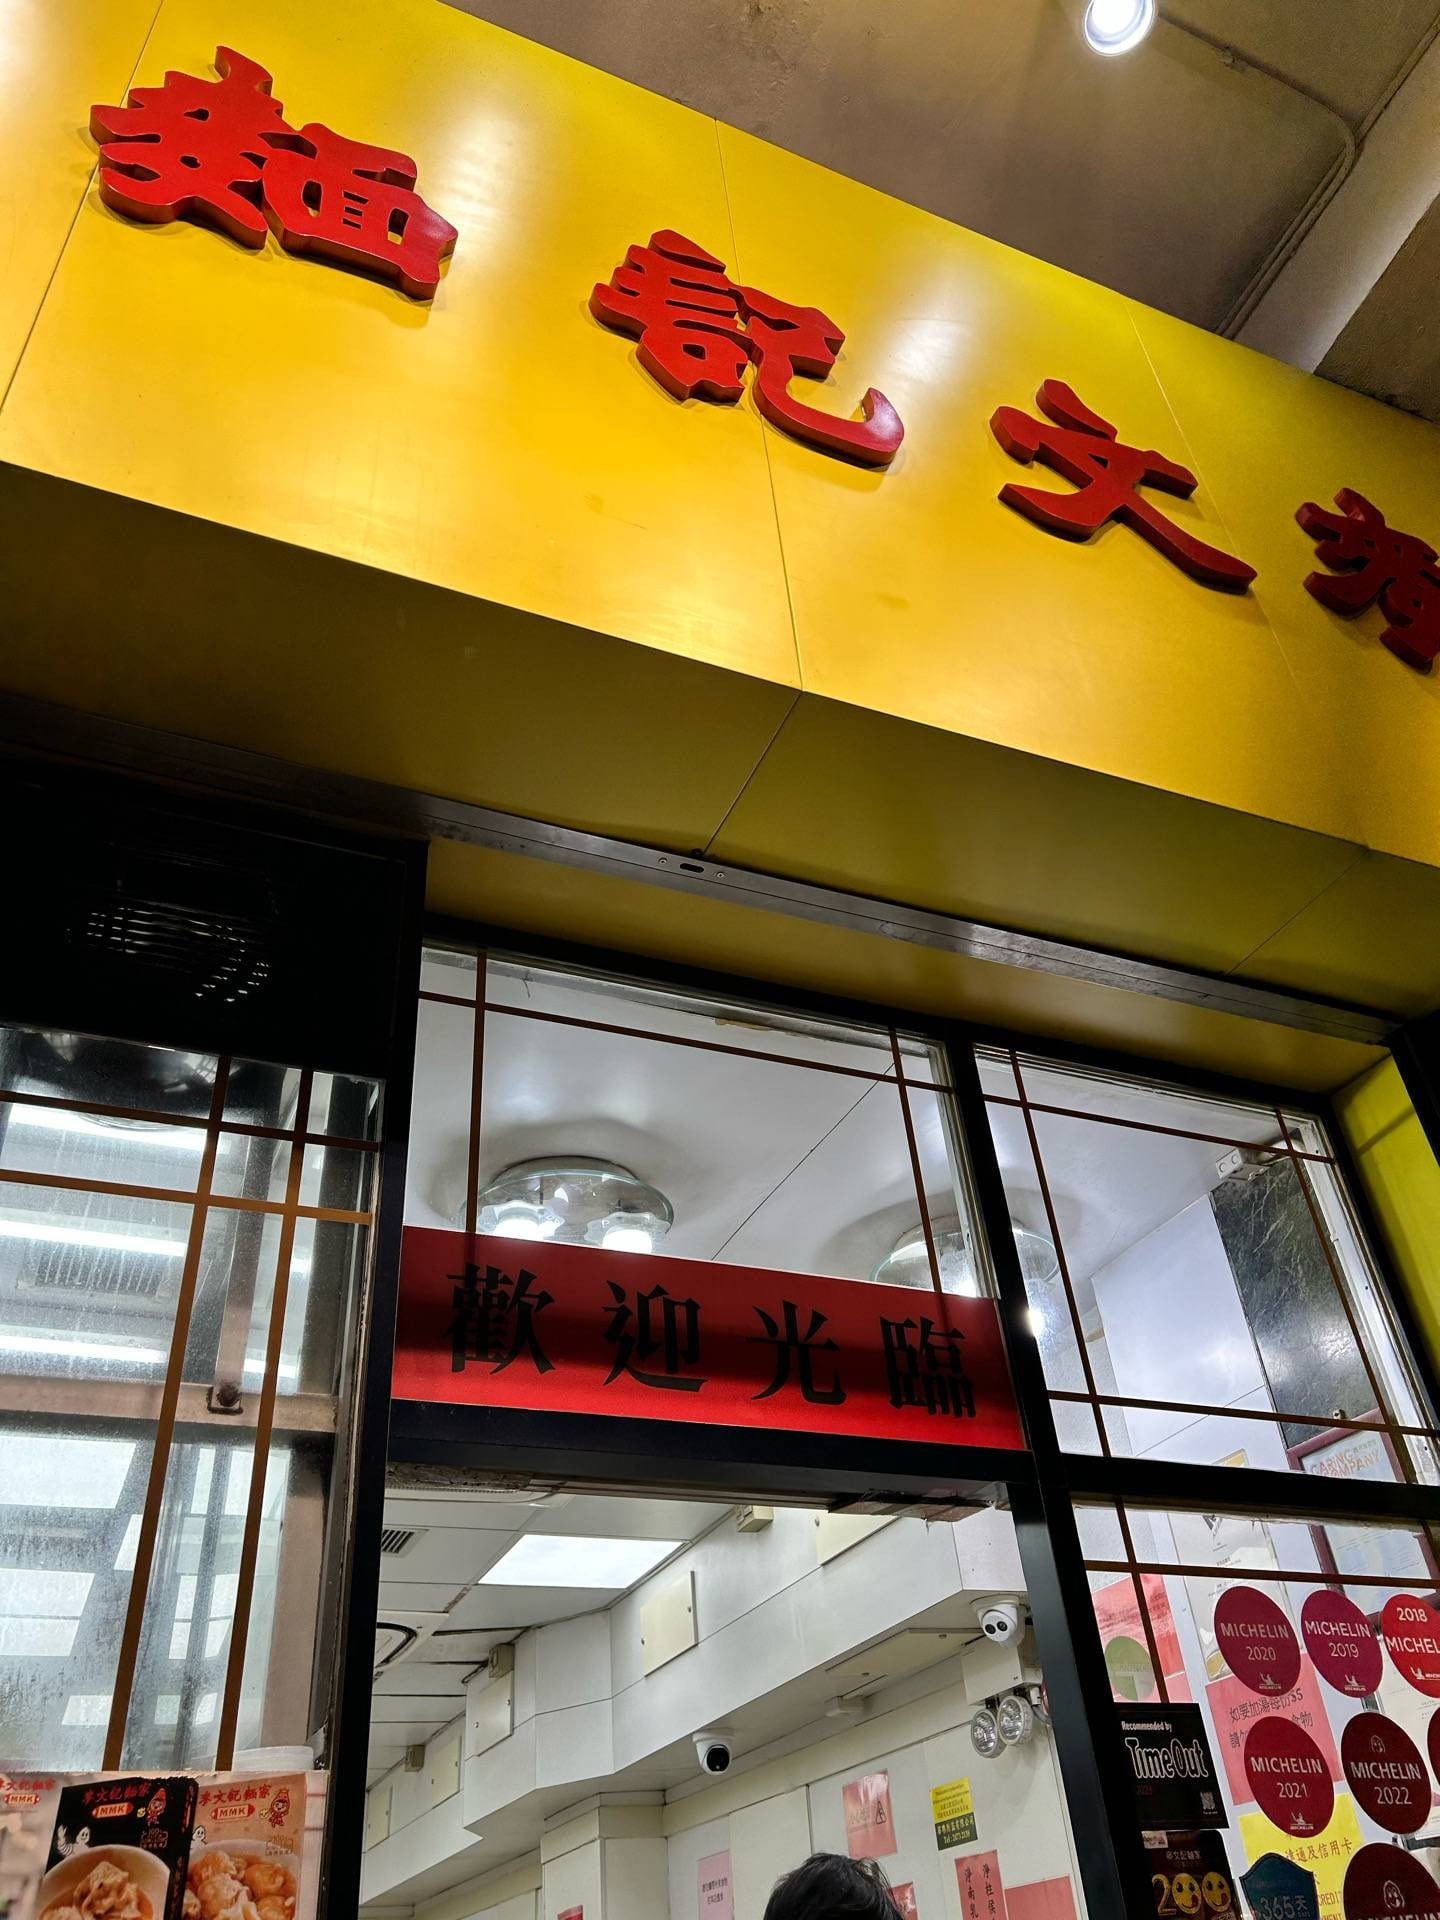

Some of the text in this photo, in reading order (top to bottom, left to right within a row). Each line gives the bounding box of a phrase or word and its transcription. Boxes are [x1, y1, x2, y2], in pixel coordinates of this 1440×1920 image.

[442, 1263, 977, 1418] 歡迎光臨
[1397, 1607, 1428, 1623] 2018
[1219, 1622, 1290, 1639] MICHELIN
[1304, 1620, 1371, 1638] MICHELIN
[1246, 1646, 1277, 1662] 2020
[1329, 1642, 1360, 1659] 2019
[1121, 1721, 1173, 1733] Recommended by
[1250, 1756, 1323, 1775] MICHELIN
[1350, 1760, 1422, 1780] MICHELIN
[1276, 1782, 1309, 1799] 2021
[1373, 1786, 1413, 1805] 2022
[99, 1804, 125, 1815] MMK
[218, 1807, 247, 1818] MMK
